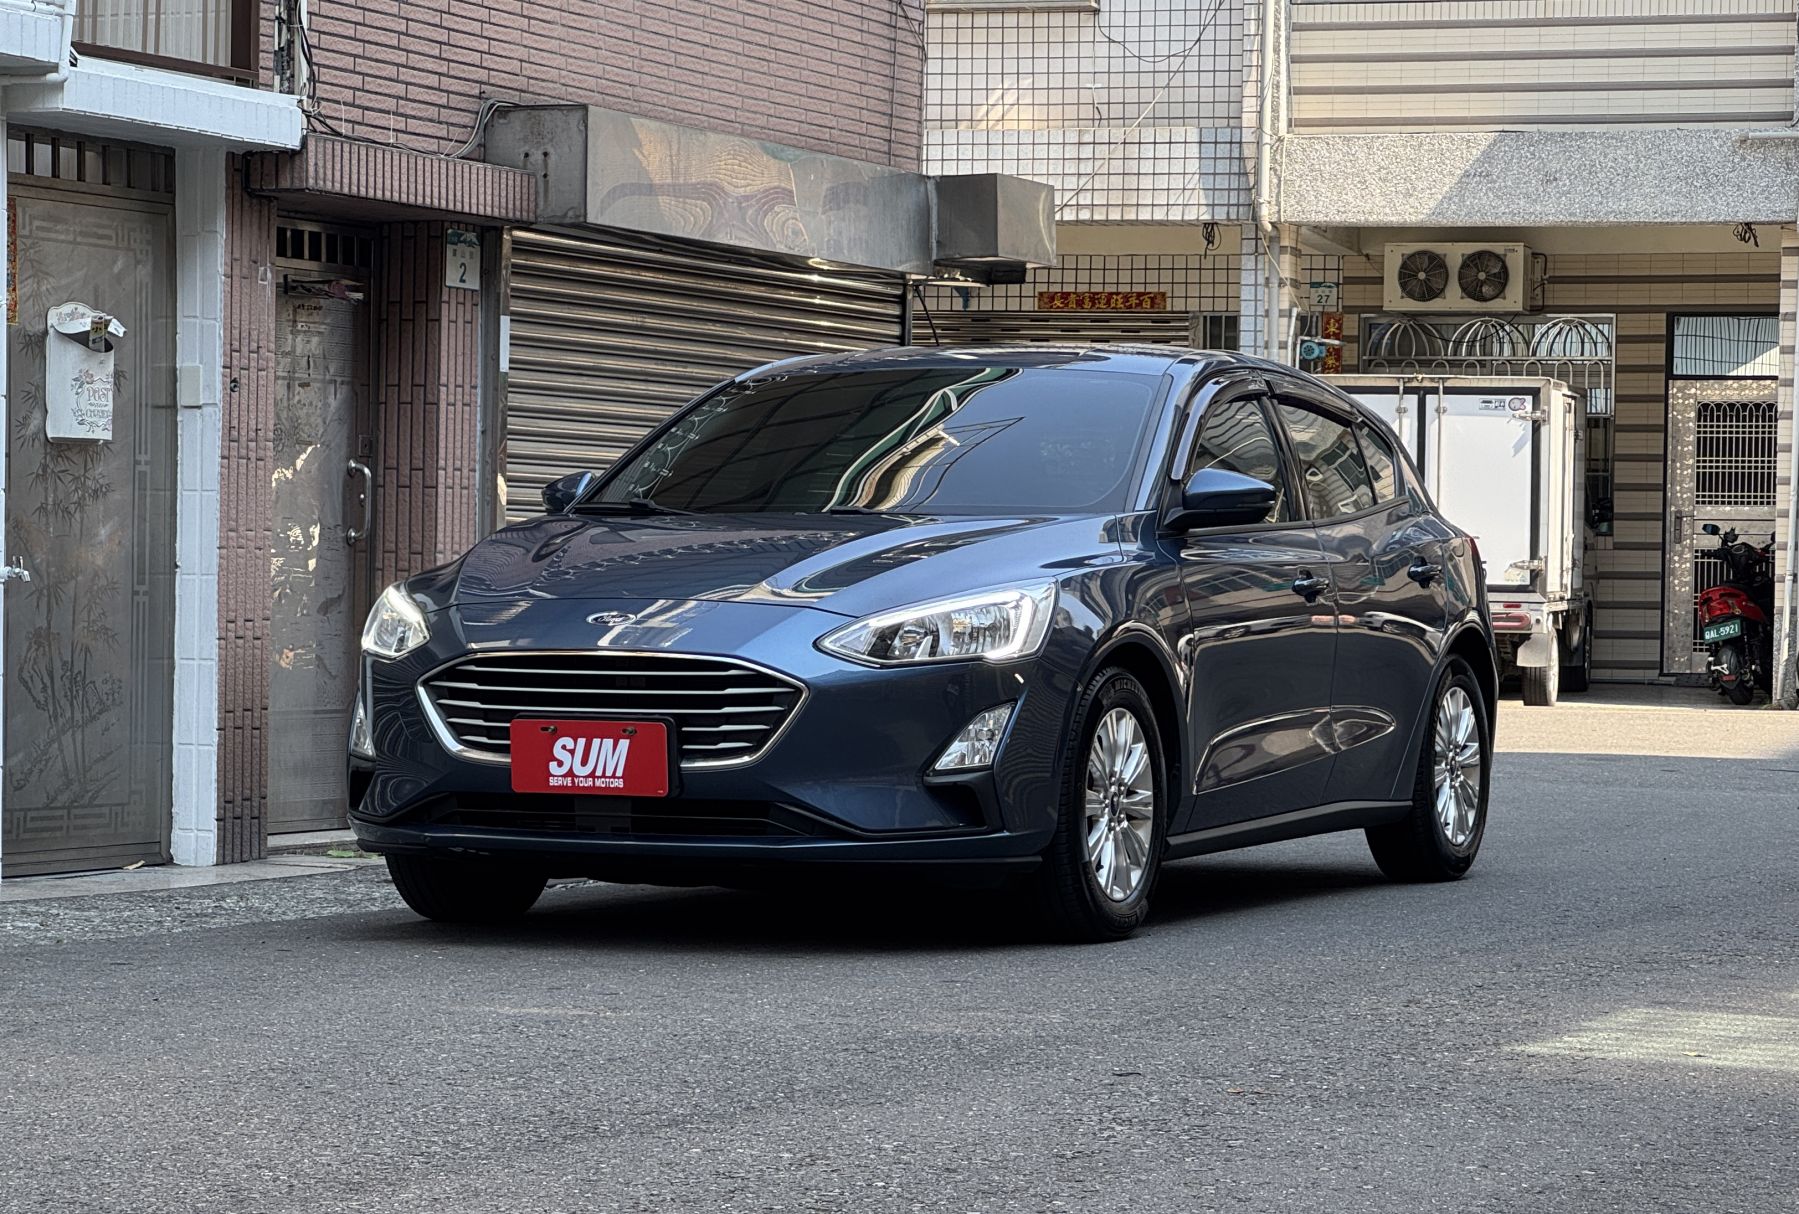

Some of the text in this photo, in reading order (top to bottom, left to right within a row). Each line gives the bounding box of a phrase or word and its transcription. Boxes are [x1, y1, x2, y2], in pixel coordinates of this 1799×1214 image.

[459, 262, 467, 284] 2
[1316, 294, 1331, 304] 27
[549, 736, 631, 777] SUM
[549, 776, 624, 788] SERVE YOUR MOTORS
